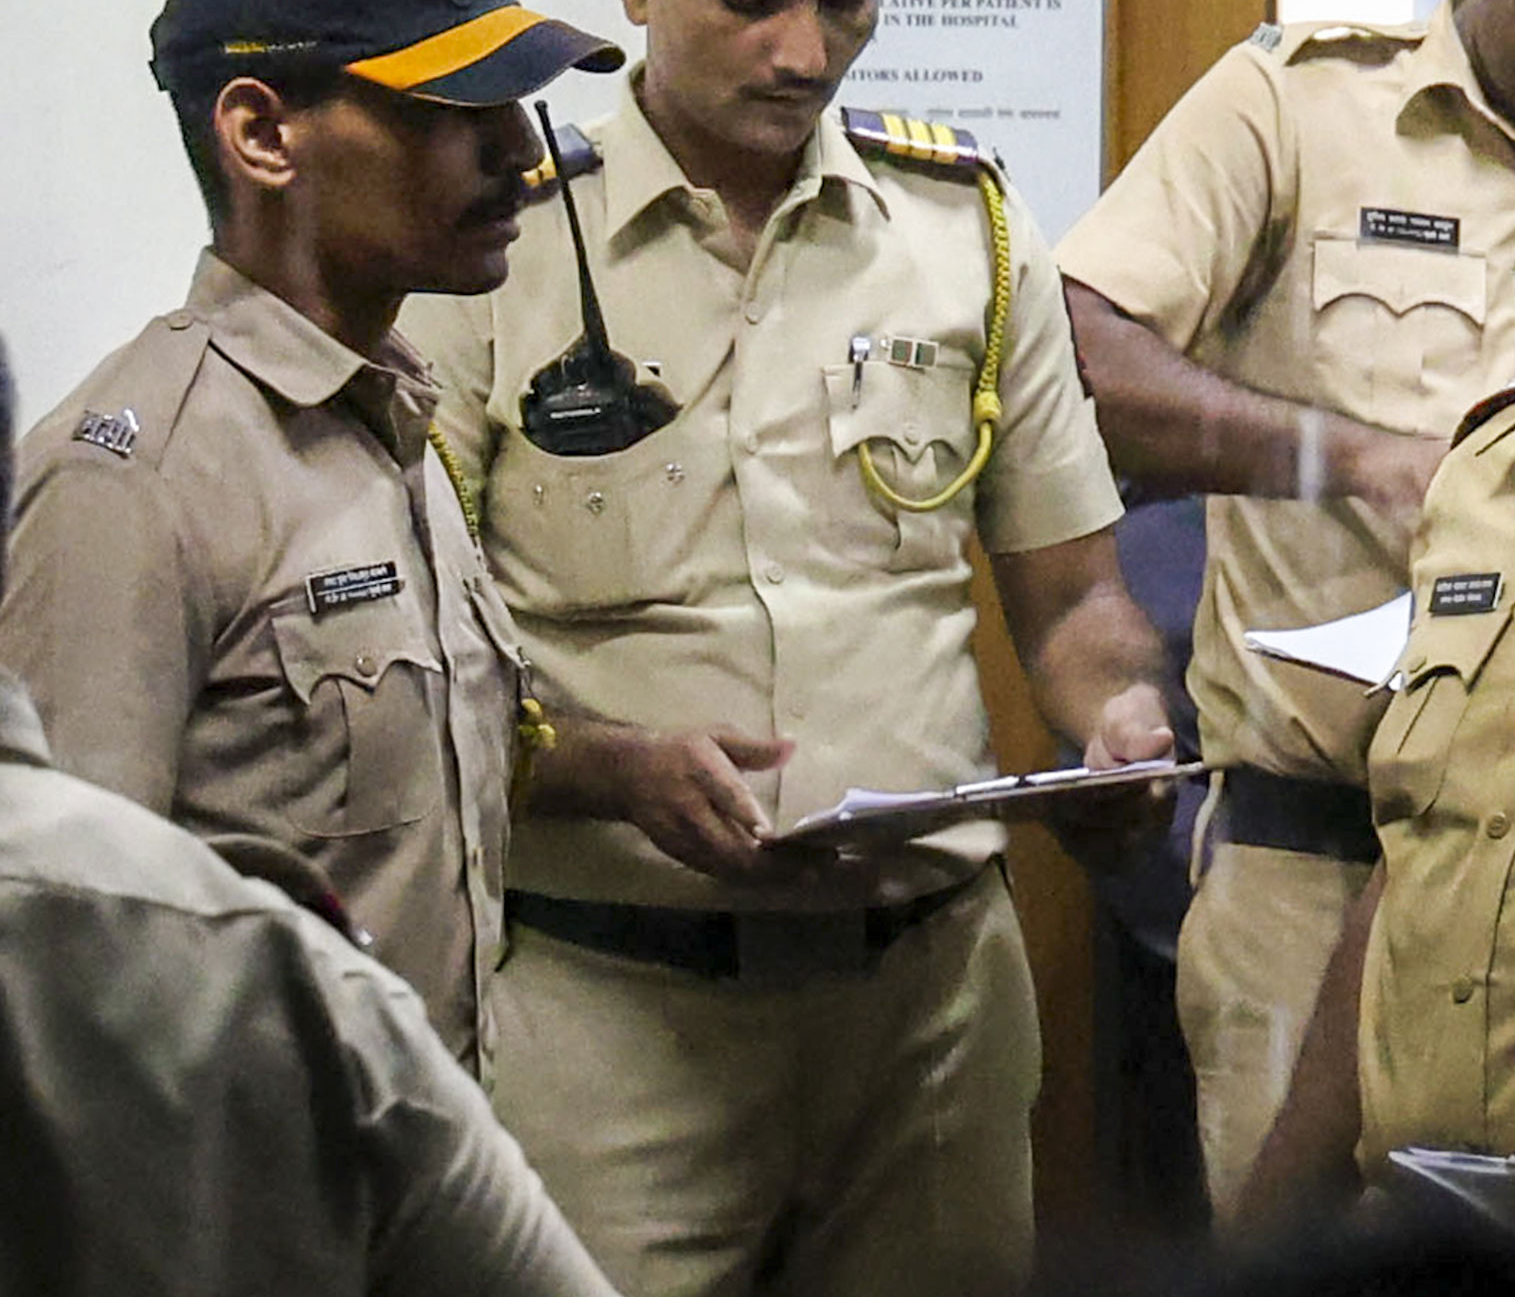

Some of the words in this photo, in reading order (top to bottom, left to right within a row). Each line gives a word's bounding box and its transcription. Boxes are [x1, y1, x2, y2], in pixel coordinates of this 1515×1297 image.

[883, 13, 901, 27] IN
[905, 14, 936, 27] THE
[941, 14, 1019, 28] HOSPITAL
[846, 69, 899, 82] ITORS
[903, 69, 984, 83] ALLOWED
